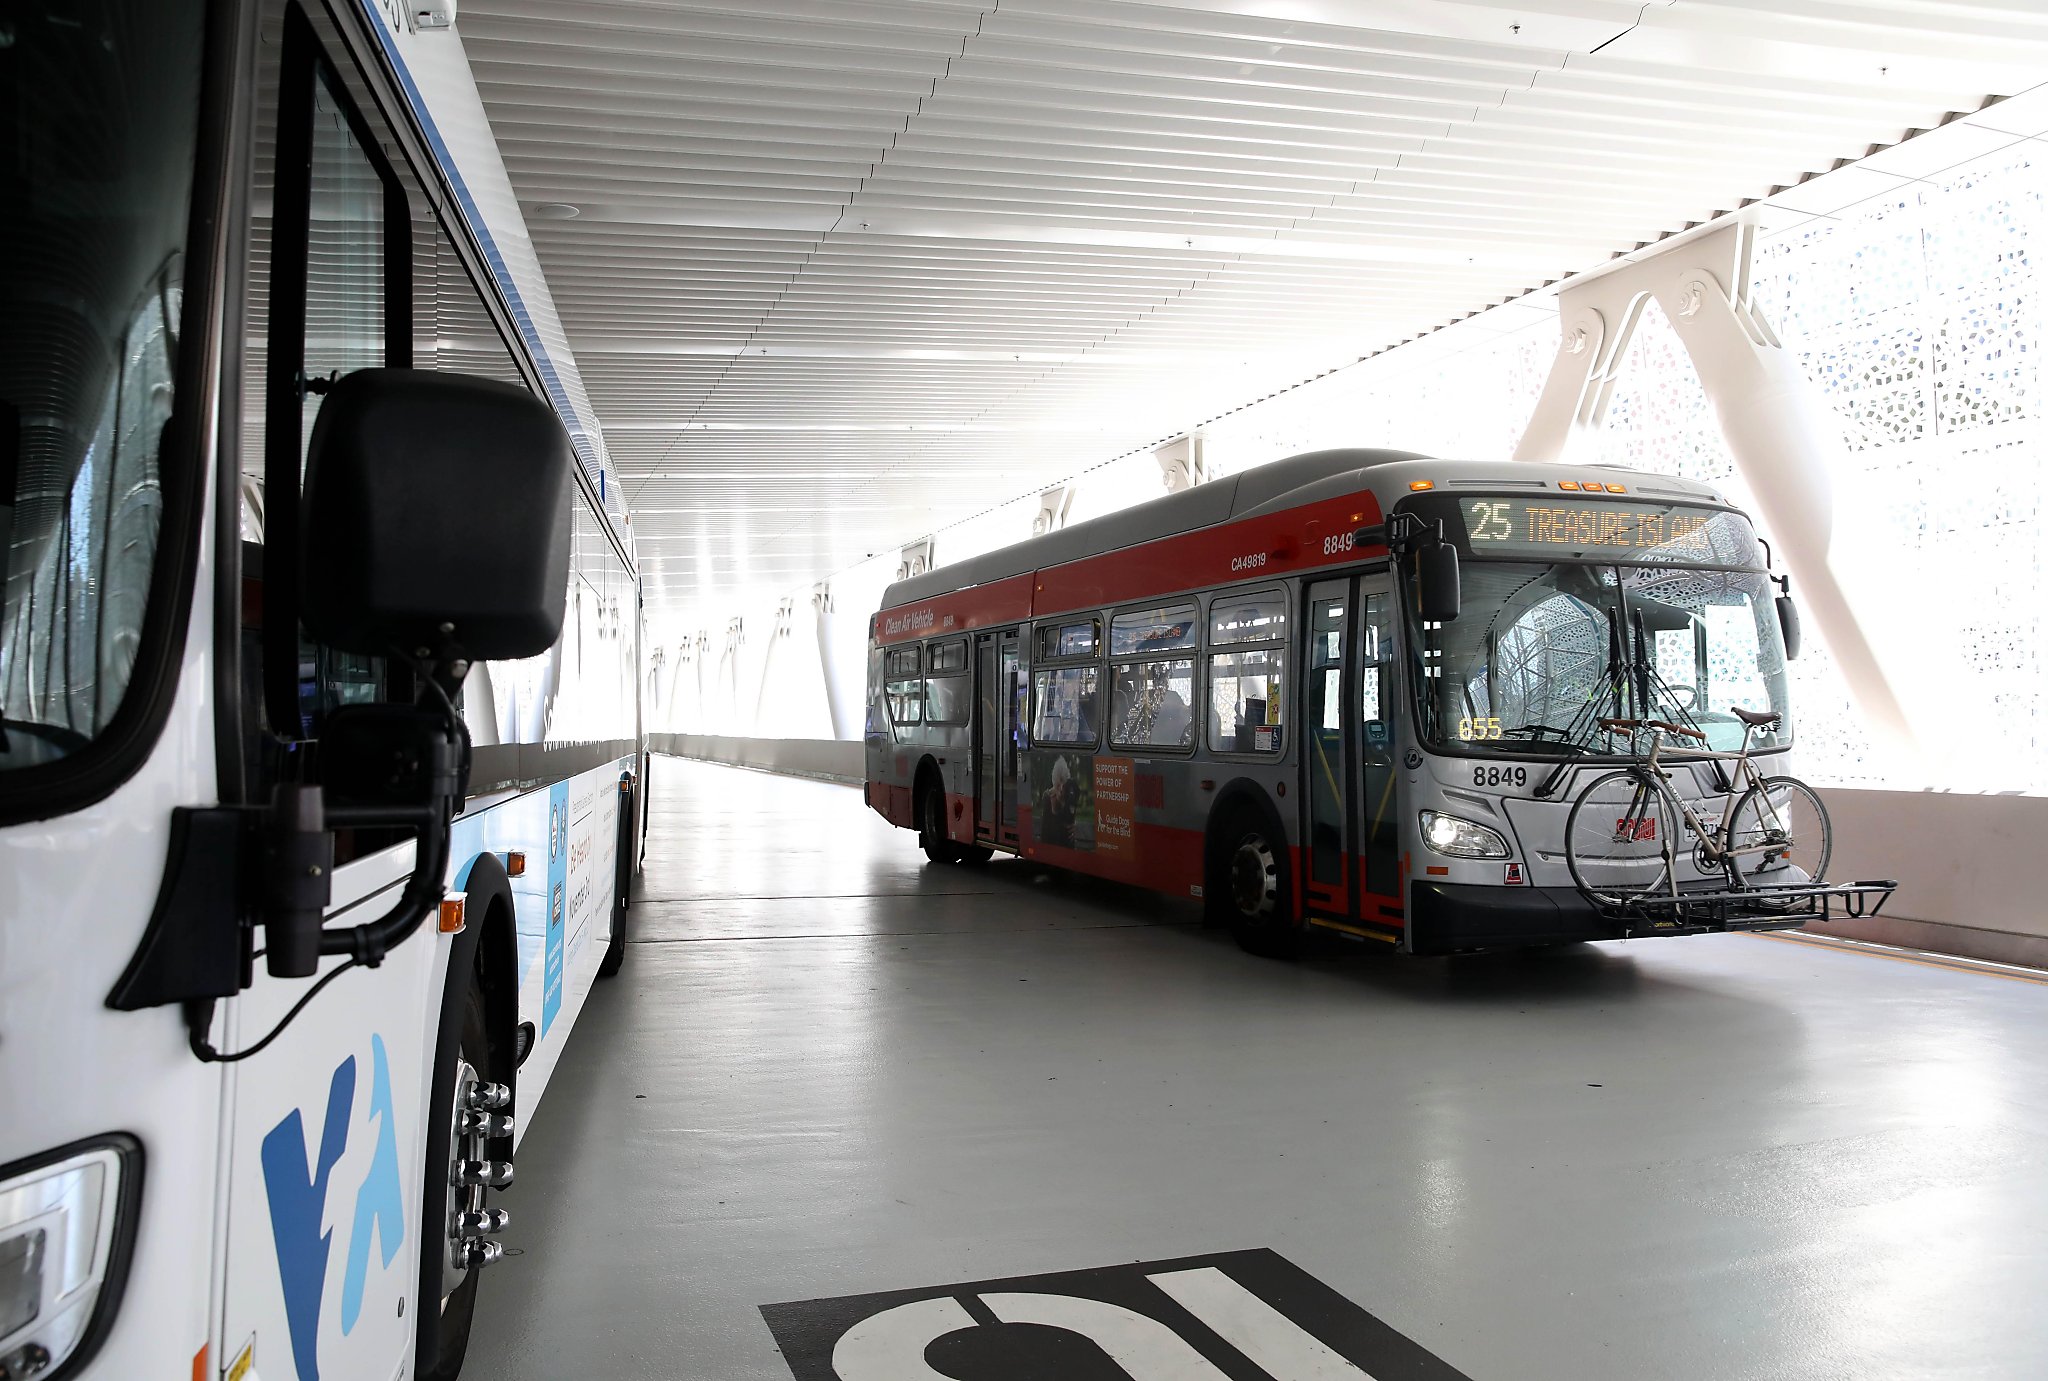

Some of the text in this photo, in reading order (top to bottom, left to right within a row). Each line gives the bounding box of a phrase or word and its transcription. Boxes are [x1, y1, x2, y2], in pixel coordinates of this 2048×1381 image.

[1470, 502, 1512, 540] 25
[1525, 507, 1631, 547] TREASURE
[1323, 532, 1353, 555] 8849
[1231, 552, 1266, 571] CA49819
[885, 608, 934, 636] Clean Air Vehicle
[1095, 763, 1128, 775] SUPPORT THE
[1473, 766, 1527, 787] 8849
[1096, 777, 1122, 788] POWER OF
[1096, 790, 1129, 802] PARTNERSHIP
[1118, 817, 1130, 827] Dogs
